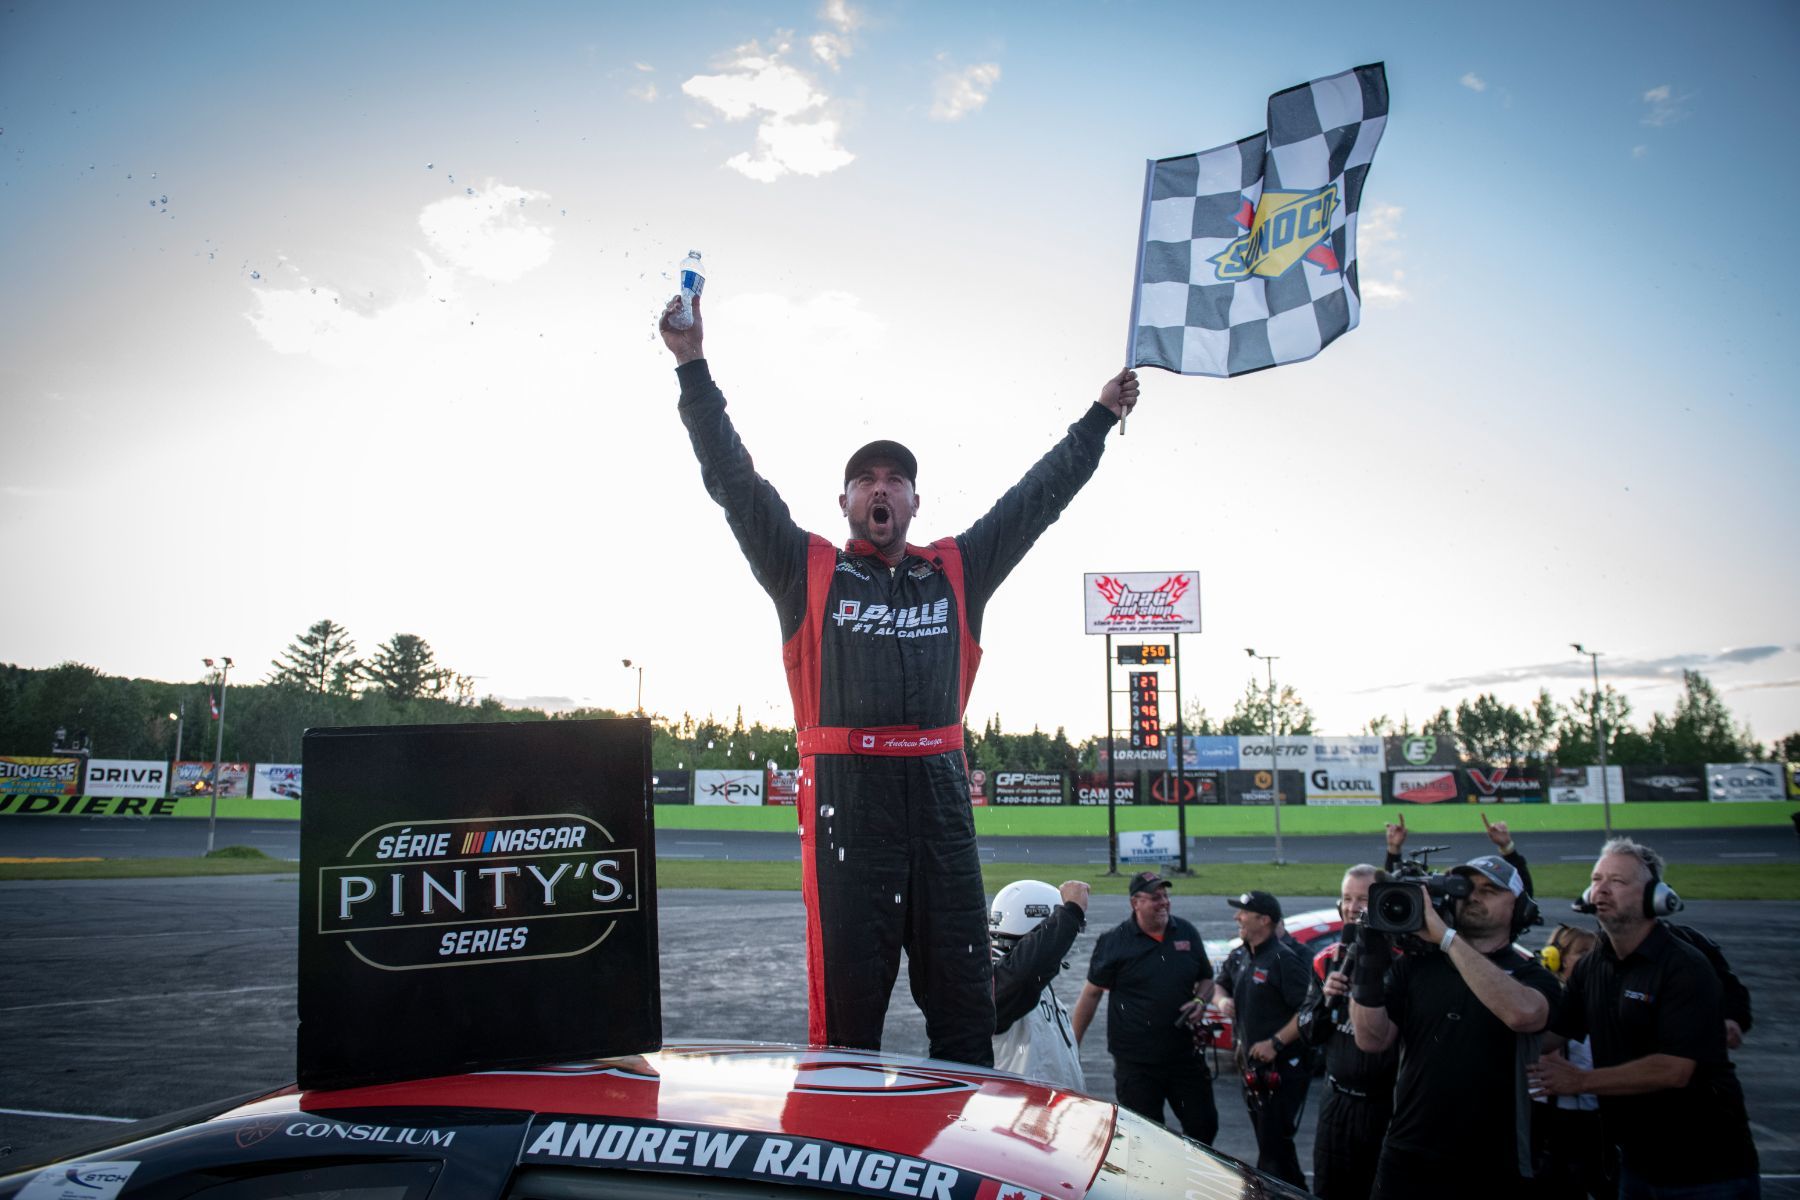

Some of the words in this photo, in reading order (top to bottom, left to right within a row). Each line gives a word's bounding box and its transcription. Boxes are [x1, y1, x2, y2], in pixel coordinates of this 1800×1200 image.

[852, 623, 871, 634] #1
[873, 625, 896, 636] AU
[897, 625, 949, 639] CANADA
[1142, 646, 1165, 657] 250
[1132, 677, 1138, 687] 1
[1140, 676, 1156, 687] 27
[1132, 691, 1140, 702] 2
[1143, 691, 1156, 702] 17
[1132, 705, 1140, 716] 3
[1141, 705, 1157, 716] 96
[1132, 720, 1140, 731] 4
[1141, 720, 1158, 731] 47
[883, 737, 919, 748] Andrew
[1133, 735, 1140, 746] 5
[1144, 735, 1158, 746] 18
[1113, 750, 1167, 760] LORACING
[90, 767, 163, 784] DRIVR
[996, 773, 1024, 786] GP
[709, 783, 759, 796] XPN
[1079, 788, 1134, 799] CAMON
[376, 827, 452, 859] SÉRIE
[491, 826, 586, 853] NASCAR
[338, 859, 624, 921] PINTY'S
[439, 926, 529, 956] SERIES
[285, 1121, 456, 1148] CONSILIUM
[526, 1120, 744, 1170] ANDREW
[754, 1139, 960, 1200] RANGER
